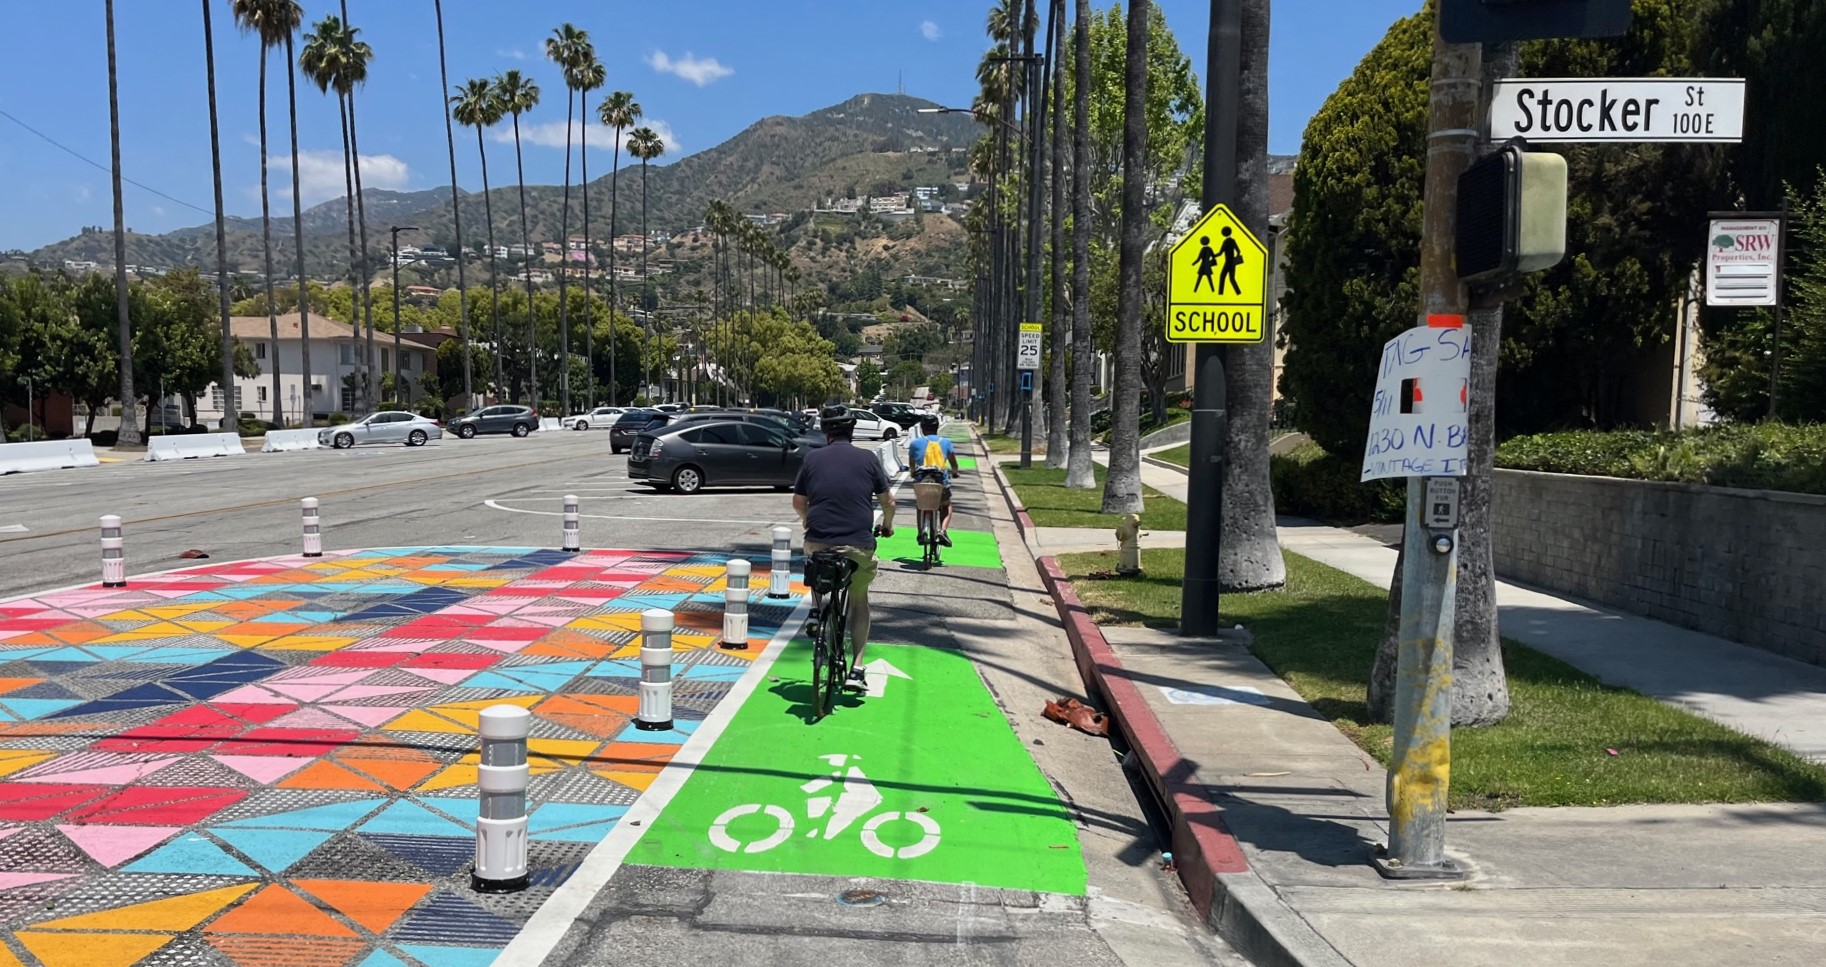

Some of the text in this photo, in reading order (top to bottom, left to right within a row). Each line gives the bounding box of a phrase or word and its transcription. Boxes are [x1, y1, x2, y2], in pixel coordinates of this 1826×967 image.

[1514, 86, 1705, 133] Stocker St
[1735, 234, 1775, 252] SRW
[1712, 253, 1773, 262] Properties, Inc.
[1174, 311, 1257, 333] SCHOOL
[1020, 345, 1038, 356] 25
